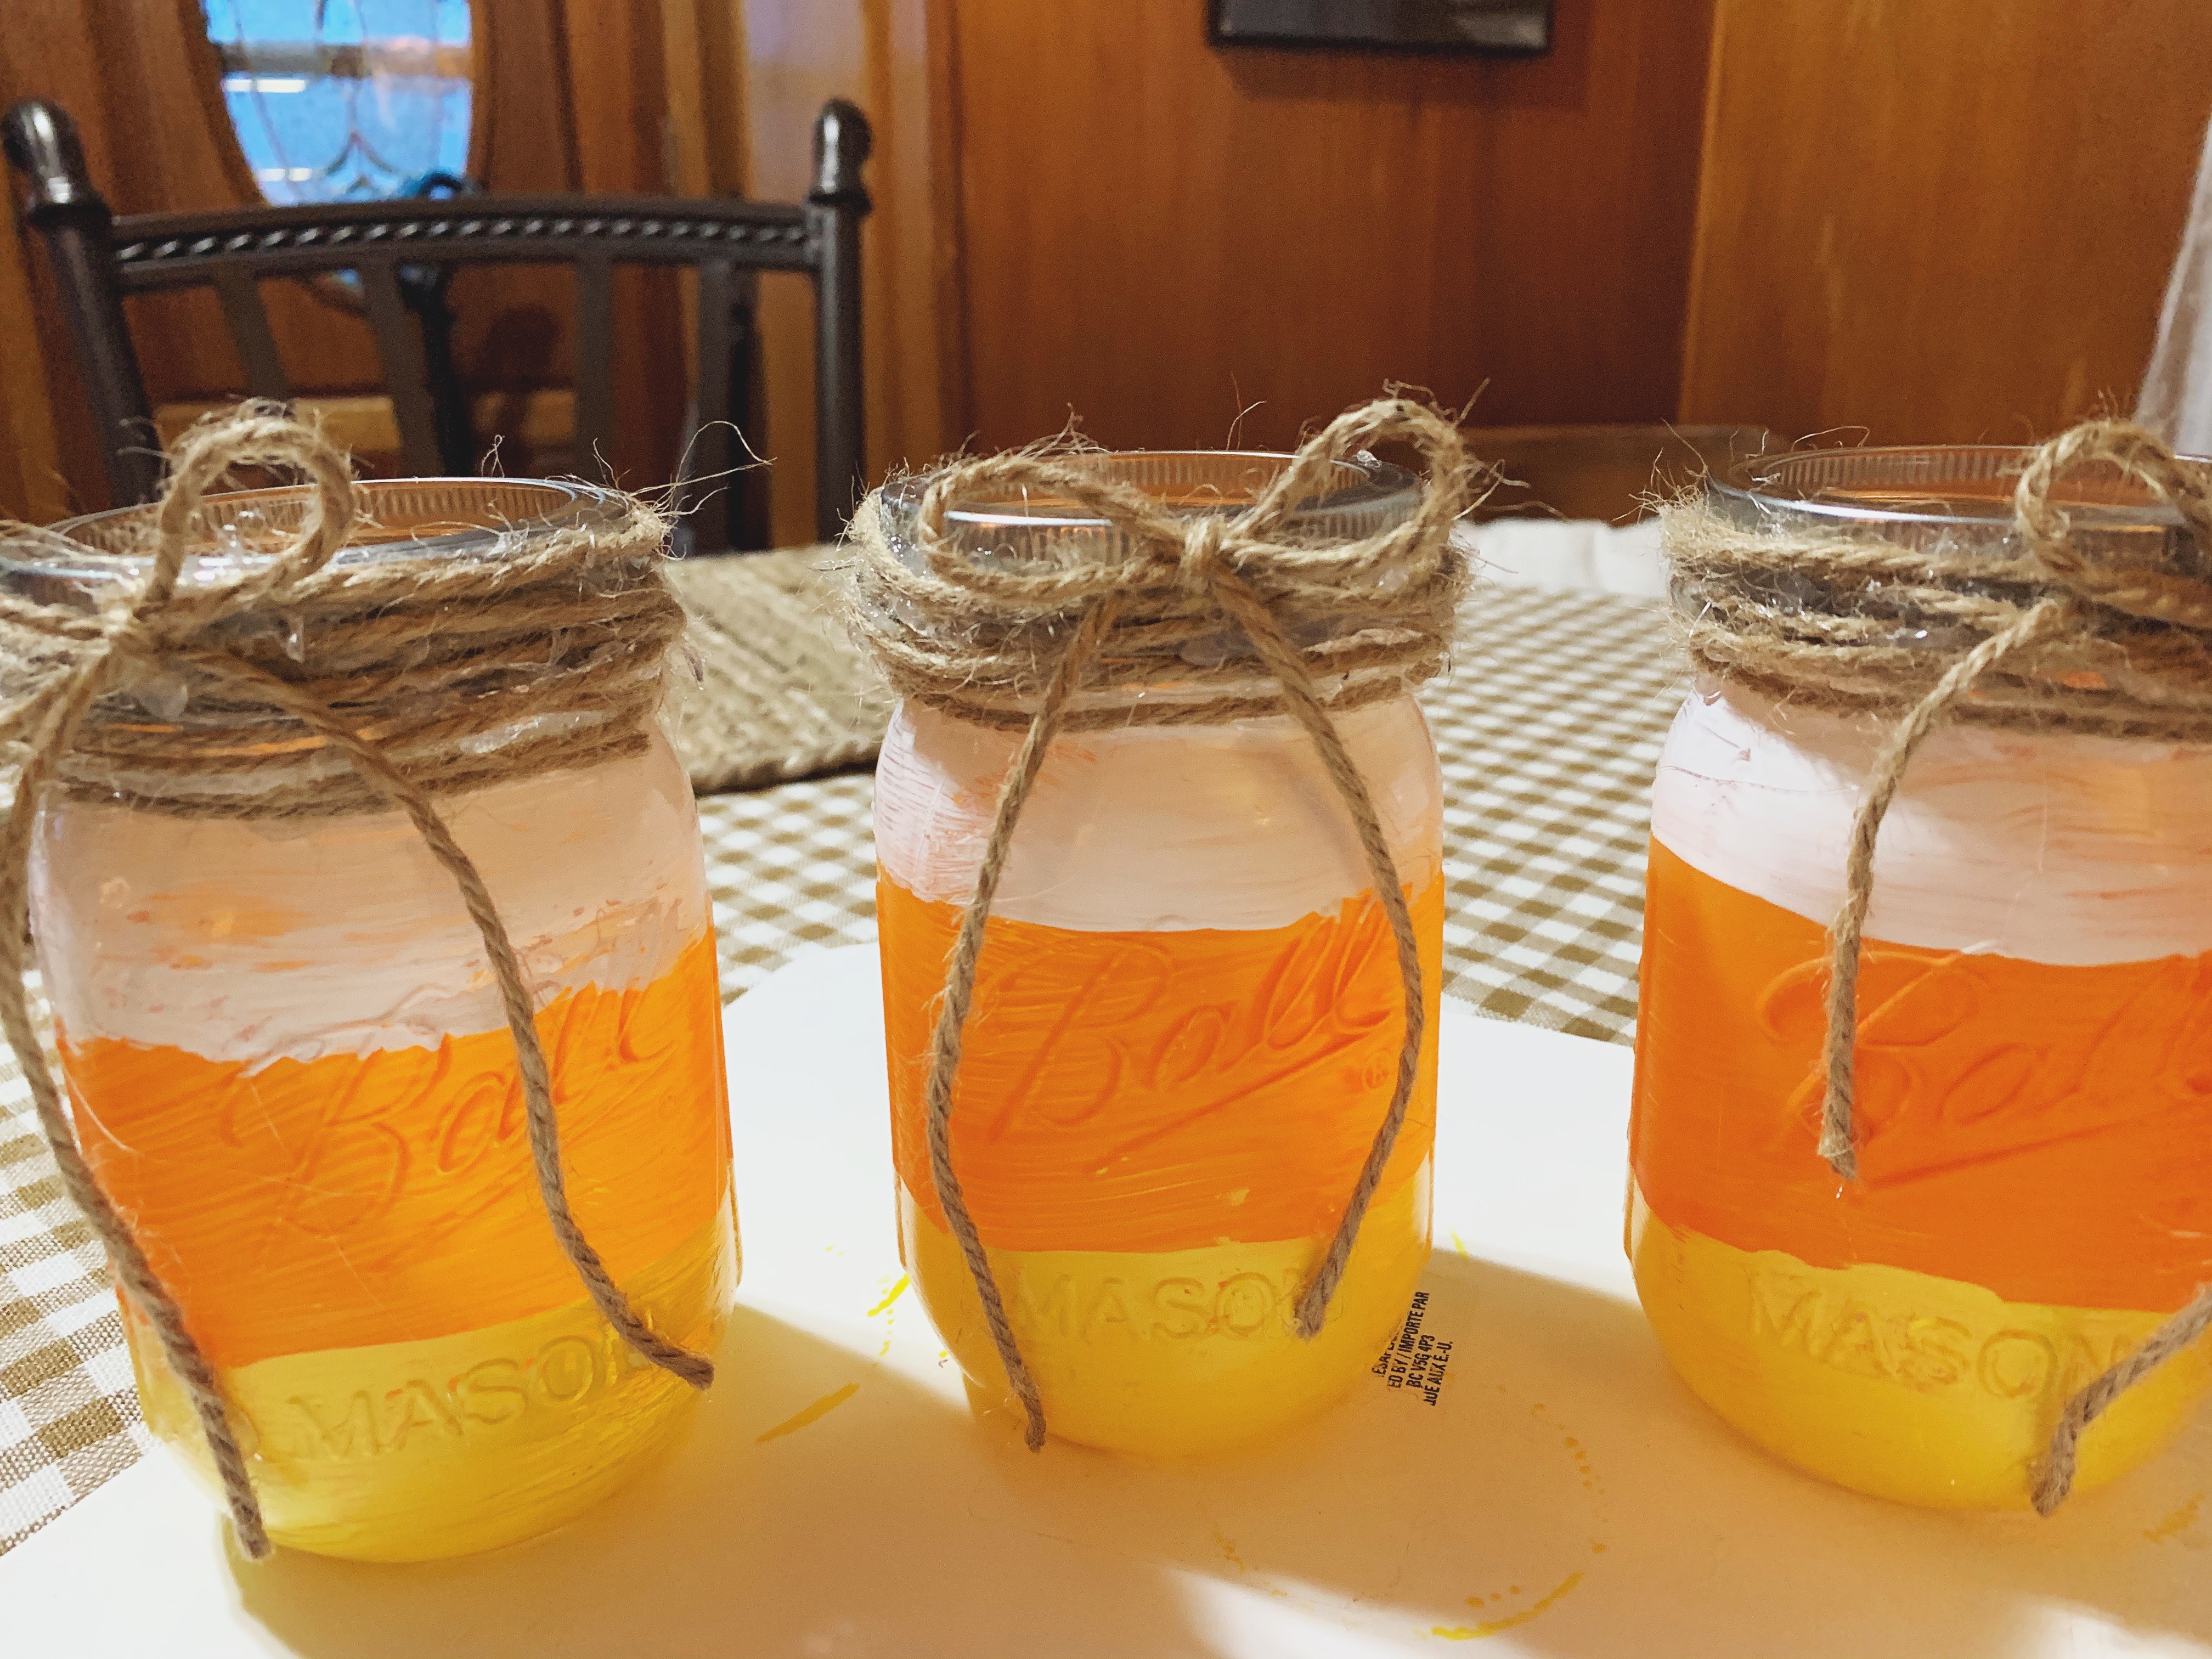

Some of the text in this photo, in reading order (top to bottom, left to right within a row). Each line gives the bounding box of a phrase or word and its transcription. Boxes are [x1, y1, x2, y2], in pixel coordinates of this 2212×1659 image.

[1411, 1291, 1430, 1311] PAR
[1397, 1310, 1424, 1353] IMPORTE
[1391, 1358, 1408, 1374] BY
[1406, 1334, 1435, 1389] BC V5G 4P3
[1426, 1362, 1447, 1385] AUX
